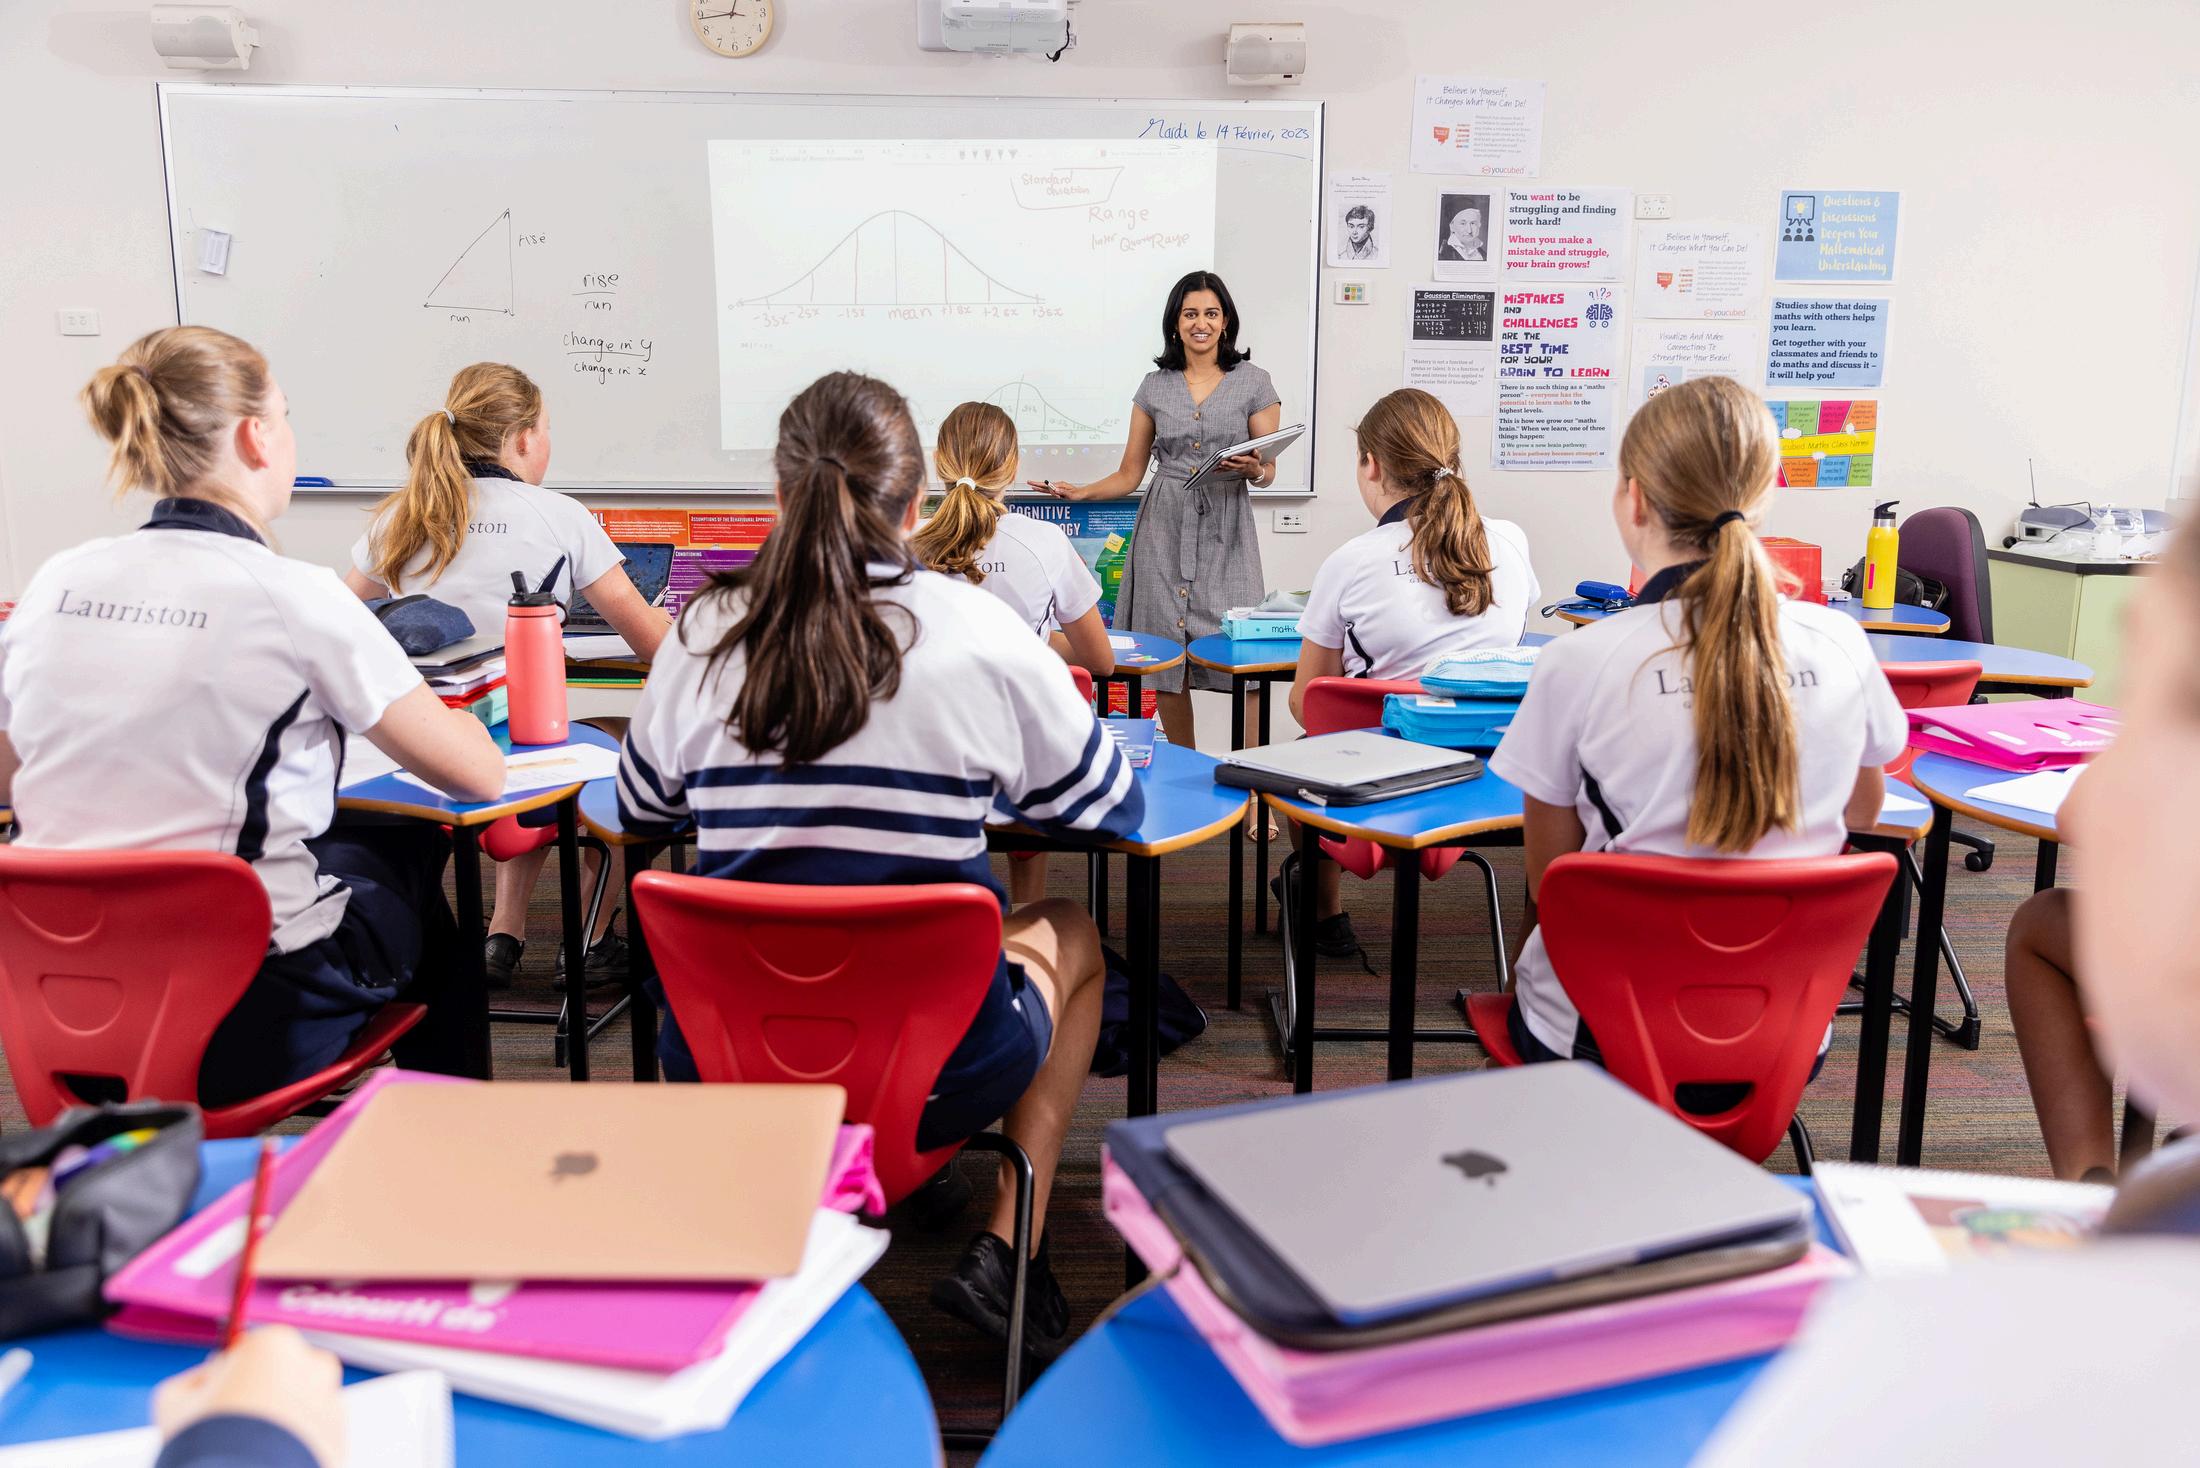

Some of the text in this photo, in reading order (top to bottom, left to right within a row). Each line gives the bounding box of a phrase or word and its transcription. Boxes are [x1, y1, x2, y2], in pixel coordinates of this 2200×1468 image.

[760, 7, 767, 17] 3
[703, 25, 710, 35] 8
[717, 38, 723, 48] 7
[731, 41, 739, 51] 6
[1442, 85, 1468, 96] Believe
[1469, 87, 1477, 95] In
[1433, 96, 1463, 110] Changes
[1465, 97, 1485, 106] What
[1485, 99, 1498, 110] You
[1499, 99, 1513, 108] Can
[1514, 99, 1528, 109] Do!
[1216, 124, 1229, 139] 14
[1510, 192, 1581, 202] You want to be
[1508, 204, 1617, 216] struggling and finding
[1088, 206, 1150, 230] Range
[1509, 217, 1562, 226] work hard!
[518, 233, 547, 247] rise
[1508, 235, 1536, 245] When
[1538, 237, 1556, 246] you
[1557, 235, 1585, 245] make
[1666, 232, 1691, 241] Believe
[1507, 247, 1610, 259] mistake and struggle,
[1658, 243, 1688, 255] Changes
[1689, 244, 1706, 252] What
[1721, 245, 1734, 253] Can
[1506, 260, 1590, 271] your brain grows!
[582, 272, 620, 288] rise
[584, 300, 612, 312] run
[1775, 301, 1877, 312] Studies show that doing
[450, 312, 471, 323] run
[1503, 317, 1578, 329] CHALLENGES
[1824, 313, 1851, 321] others
[1852, 313, 1875, 323] helps
[1772, 325, 1789, 333] you
[1501, 332, 1541, 340] ARE THE
[562, 331, 614, 363] change
[619, 338, 633, 350] in
[1501, 343, 1533, 354] BEST
[1789, 339, 1825, 348] together
[1827, 339, 1846, 347] with
[1847, 341, 1867, 349] your
[1771, 350, 1819, 358] classmates
[1820, 350, 1837, 358] and
[1838, 350, 1868, 358] friends
[1830, 361, 1862, 369] discuss
[574, 362, 614, 385] change
[619, 365, 632, 376] in
[1543, 367, 1564, 377] TO
[1570, 367, 1610, 377] LEARN
[1769, 371, 1836, 381] it will help you!
[1551, 384, 1569, 392] thing
[55, 589, 208, 630] Lauriston
